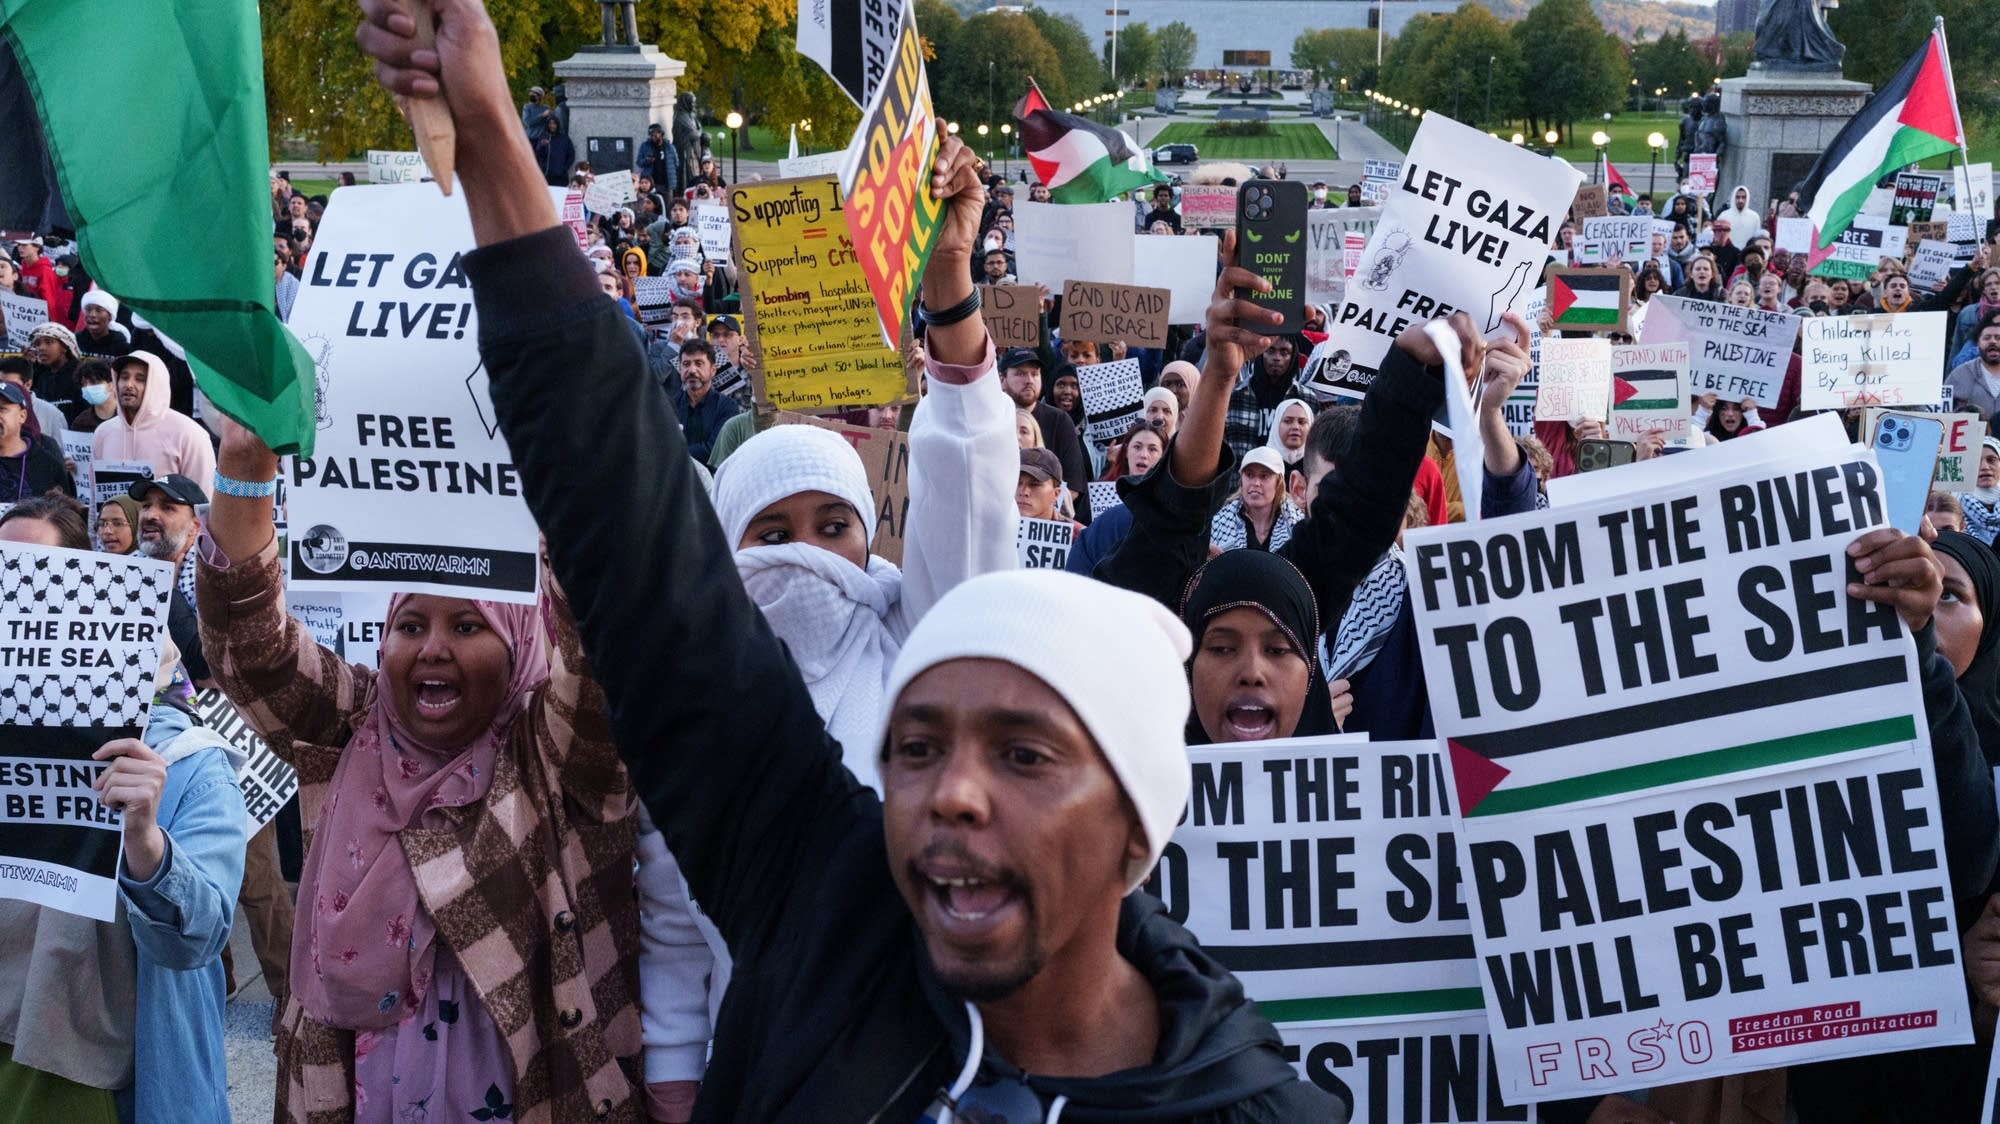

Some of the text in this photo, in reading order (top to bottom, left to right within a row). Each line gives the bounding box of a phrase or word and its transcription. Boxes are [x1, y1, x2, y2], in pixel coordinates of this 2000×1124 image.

[853, 28, 920, 229] SOLID
[369, 154, 422, 165] LET GAZA
[380, 168, 412, 181] LIVE
[1388, 169, 1399, 177] SEA
[732, 185, 820, 228] Supporting
[1402, 164, 1550, 244] LET GAZA
[1580, 192, 1596, 200] NO
[1895, 196, 1933, 208] WILL BE
[1424, 214, 1510, 268] LIVE!
[1584, 222, 1648, 240] CEASEFIRE
[1256, 253, 1290, 264] DONT
[1601, 240, 1626, 259] NOW
[1836, 247, 1869, 260] FREE
[310, 251, 475, 289] LET GA
[742, 245, 817, 277] Supporting
[1263, 275, 1281, 286] MY
[1907, 273, 1939, 281] PALESTIN
[762, 287, 811, 305] bombing
[1069, 282, 1164, 314] END US AID
[1252, 289, 1293, 299] PHONE
[3, 301, 47, 316] LET GAZA
[12, 312, 36, 322] LIVE!
[1681, 300, 1787, 325] FROM THE RIVER
[346, 301, 471, 340] LIVE!
[794, 318, 848, 336] phosphorus
[854, 317, 871, 328] gas
[983, 317, 1037, 342] THEID
[1069, 311, 1161, 340] TO ISRAEL
[1699, 316, 1767, 338] TO THE SEA
[1808, 320, 1912, 341] Children Are
[770, 345, 803, 357] Starve
[1544, 342, 1595, 362] BOMBIN
[1613, 349, 1687, 367] STAND WITH
[1704, 341, 1777, 368] PALESTINE
[1813, 342, 1911, 371] Being Killed
[811, 363, 828, 374] out
[856, 359, 878, 370] blood
[1542, 363, 1576, 384] KIDS
[1082, 375, 1138, 394] FROM THE RIVER
[1705, 373, 1769, 399] BE FREE
[1818, 371, 1888, 392] By Our
[829, 386, 872, 401] hostages
[1540, 387, 1574, 417] SELF
[357, 414, 455, 449] FREE
[1092, 426, 1125, 440] WILL BE
[1093, 413, 1139, 431] PALESTINE
[1615, 416, 1687, 434] PALESTINE
[293, 454, 518, 497] PALESTINE
[1028, 521, 1071, 545] RIVER
[1416, 461, 1884, 613] FROM THE RIVER
[350, 550, 490, 576] @ANTIWARMN
[292, 604, 343, 619] exposing
[8, 620, 155, 642] THE RIVER
[305, 616, 339, 631] truth
[1433, 554, 1902, 720] TO THE SEA
[2, 647, 115, 668] THE SEA
[199, 688, 297, 800] PALESTINE
[0, 762, 108, 788] ESTIN
[1263, 756, 1361, 824] THE
[7, 794, 46, 818] BE
[1468, 767, 1938, 940] PALESTINE
[0, 863, 78, 893] TIWARMN
[1217, 837, 1358, 930] THE
[1385, 832, 1469, 923] SE
[1485, 886, 1956, 1030] WILL BE FREE
[1736, 1003, 1855, 1033] Freedom Road
[1737, 1010, 1934, 1050] Socialist Organization
[1526, 1020, 1714, 1087] FRSO
